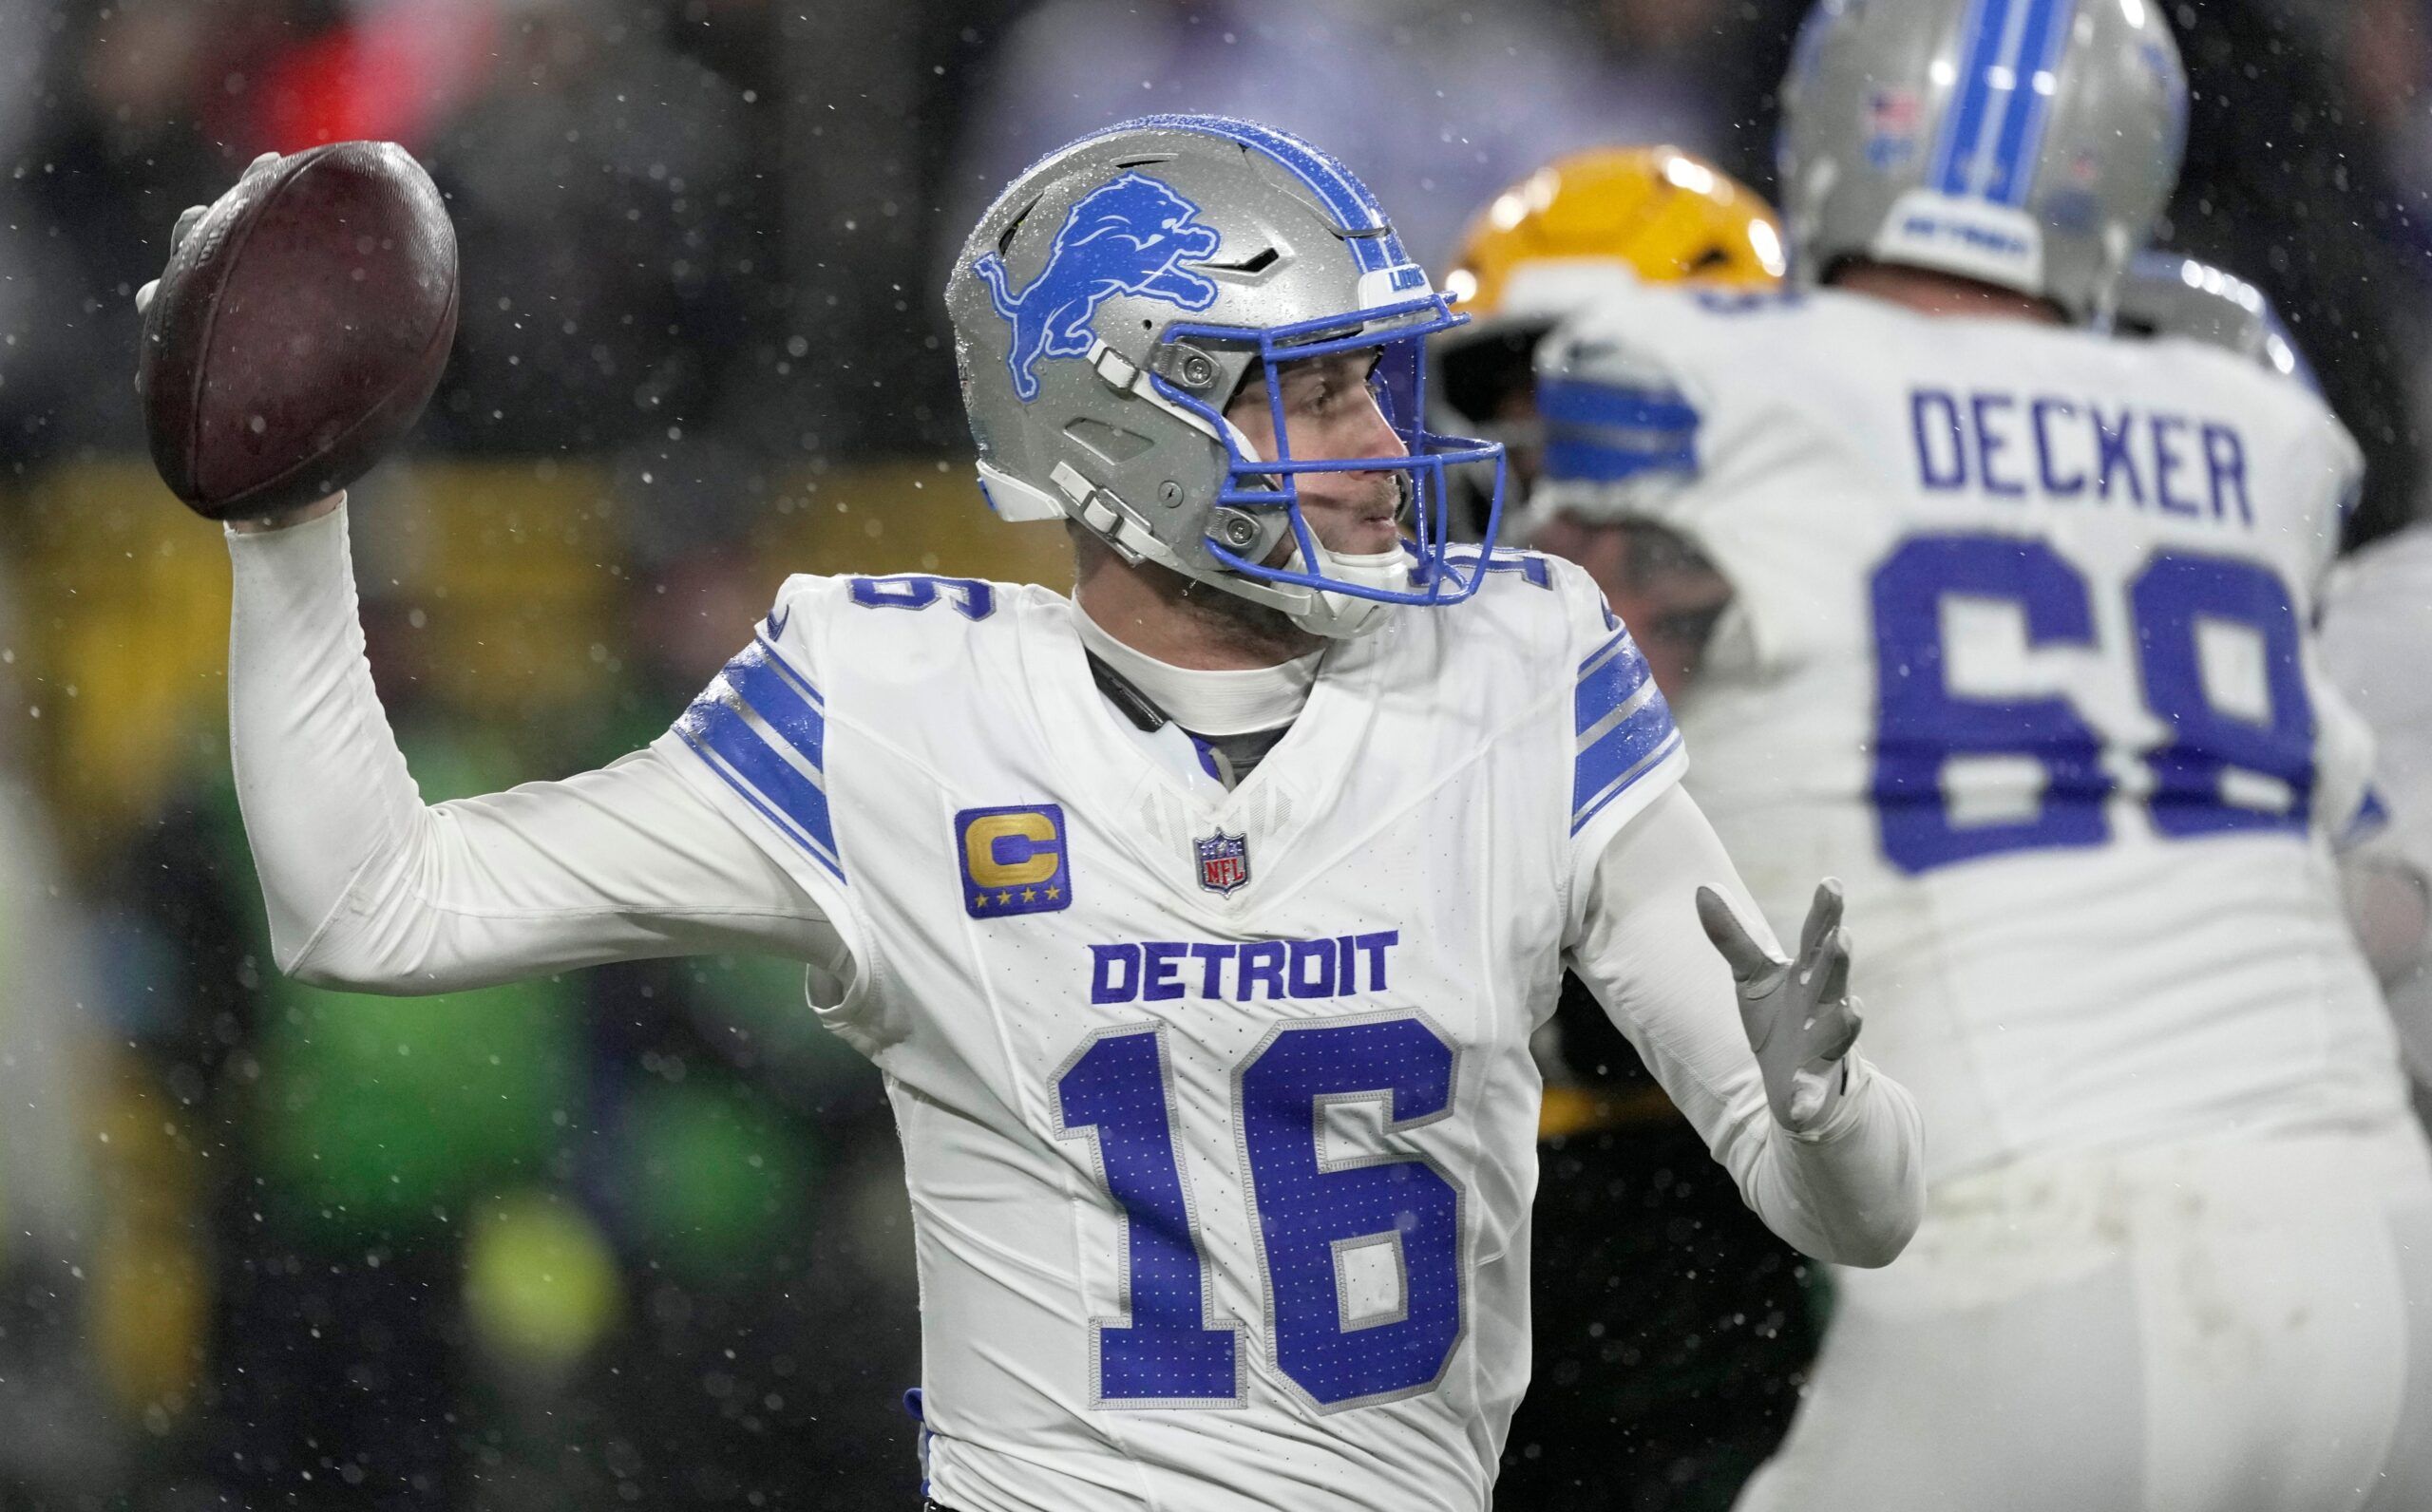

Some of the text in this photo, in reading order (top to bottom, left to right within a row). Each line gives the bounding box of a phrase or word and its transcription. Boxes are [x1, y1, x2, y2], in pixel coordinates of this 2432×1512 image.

[1910, 387, 2253, 533] DECKER
[1870, 532, 2316, 879] 68
[965, 812, 1059, 888] C
[1205, 858, 1245, 885] NFL
[1087, 930, 1399, 1005] DETROIT
[1048, 1006, 1468, 1416] 16
